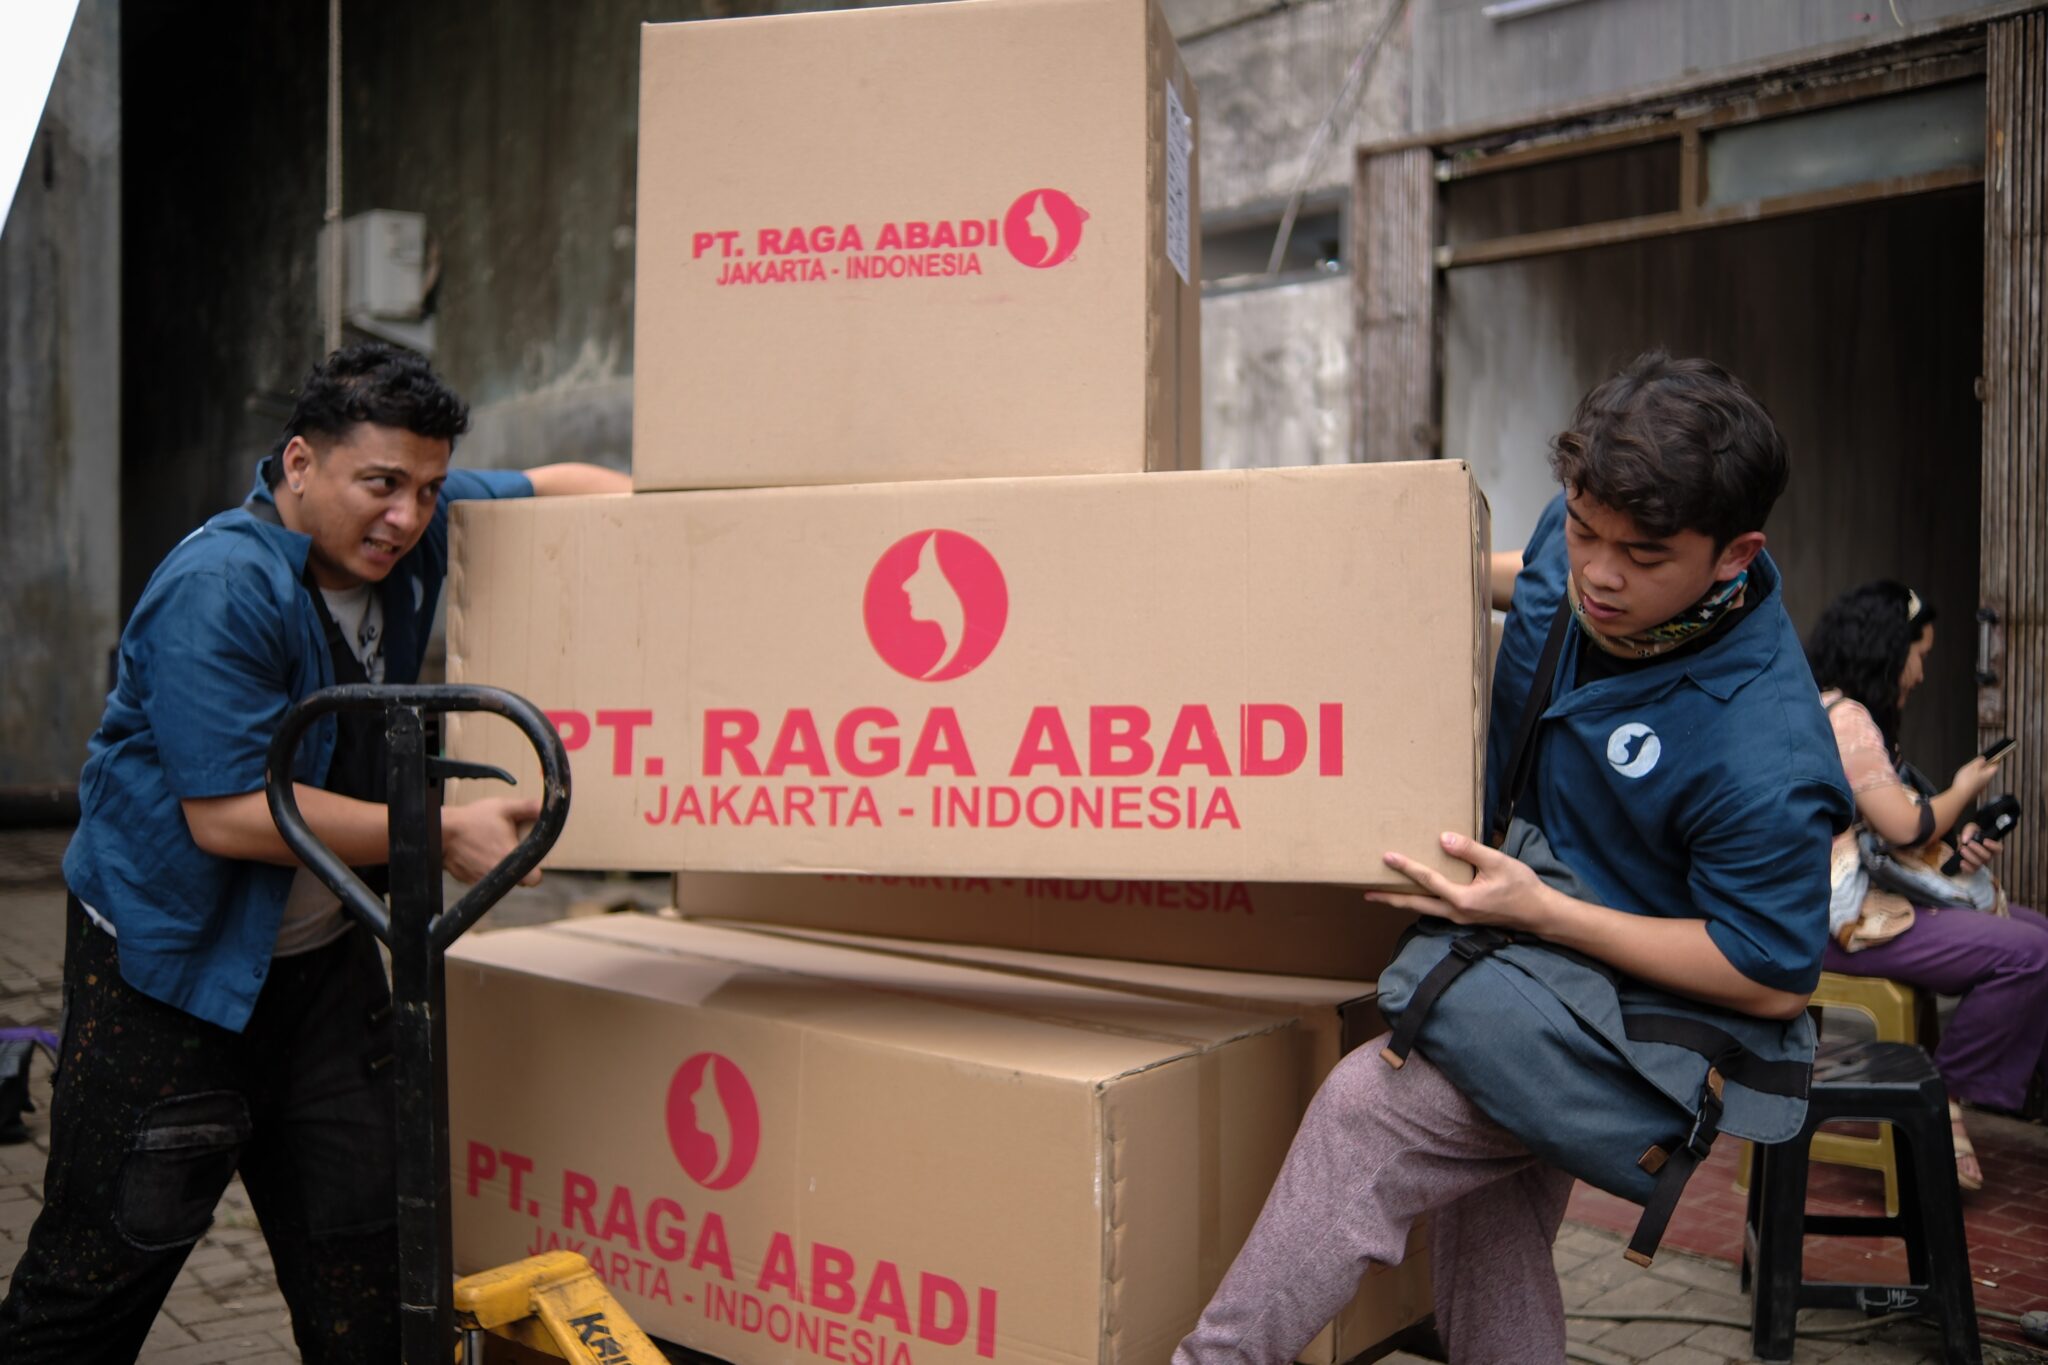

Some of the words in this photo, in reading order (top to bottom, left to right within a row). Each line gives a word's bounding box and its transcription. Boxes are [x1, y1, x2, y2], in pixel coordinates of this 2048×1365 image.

[692, 230, 744, 258] PT.
[759, 225, 863, 256] RAGA
[877, 220, 998, 250] ABADI
[717, 258, 826, 285] JAKARTA
[848, 252, 981, 279] INDONESIA
[544, 709, 663, 777] PT.
[704, 707, 976, 777] RAGA
[1010, 703, 1343, 777] ABADI
[645, 786, 881, 826] JAKARTA
[900, 808, 913, 816] -
[933, 786, 1240, 829] INDONESIA
[467, 1140, 540, 1216] PT.
[562, 1170, 735, 1281] RAGA
[757, 1232, 997, 1358] ABADI
[705, 1284, 912, 1365] INDONESIA
